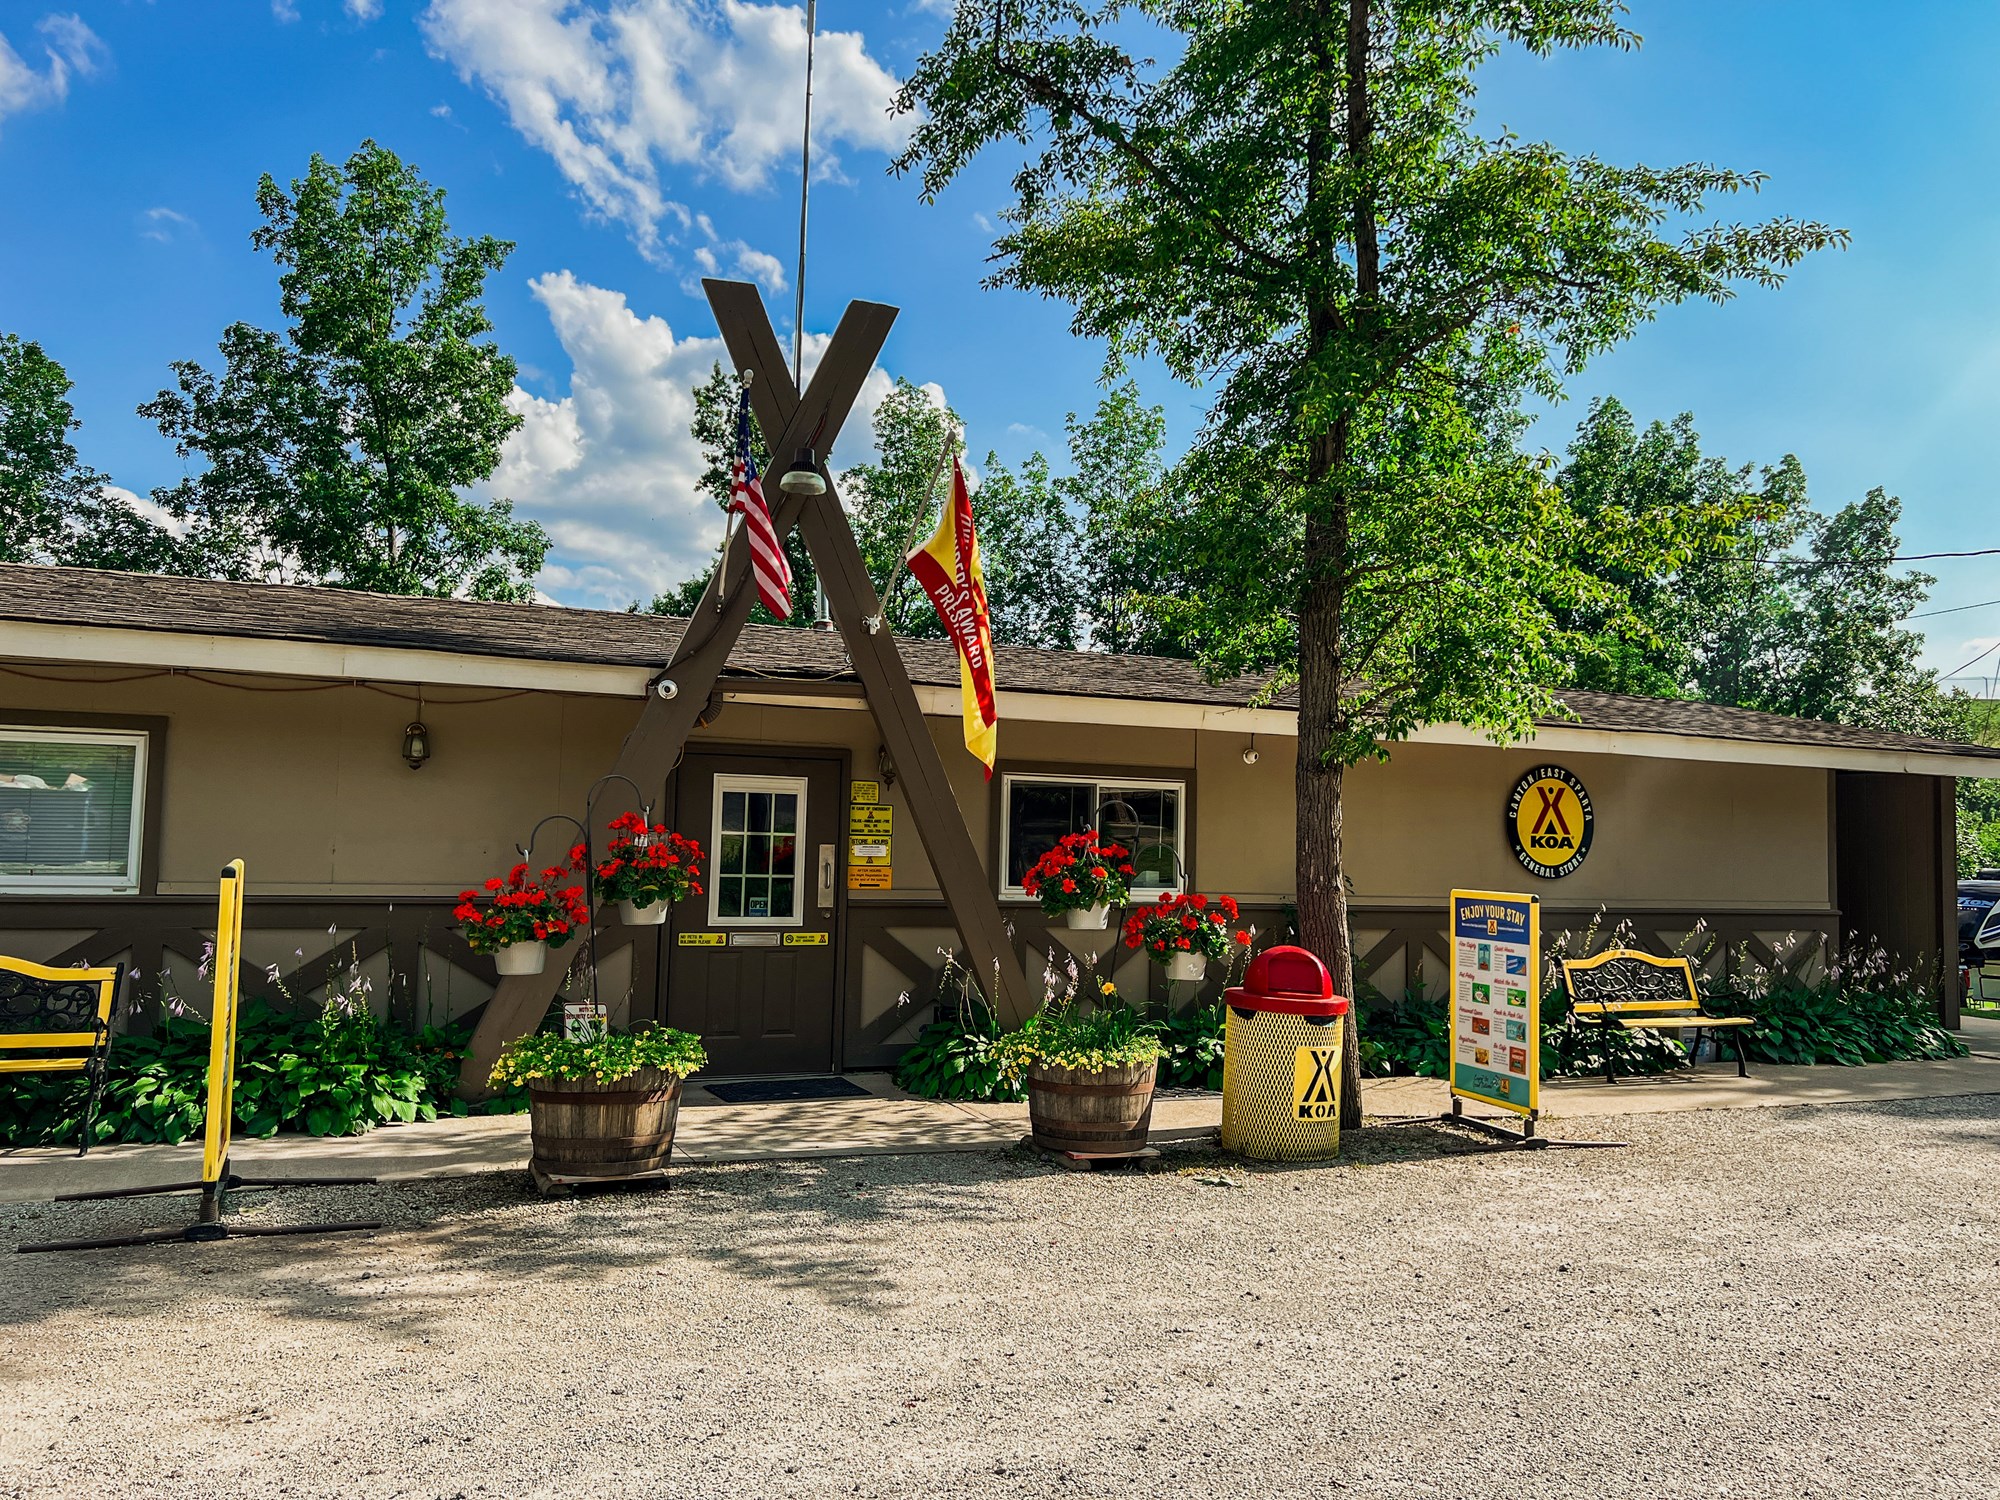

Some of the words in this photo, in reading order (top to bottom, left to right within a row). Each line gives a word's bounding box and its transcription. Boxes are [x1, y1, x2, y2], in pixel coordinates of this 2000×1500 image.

[958, 607, 983, 669] AWARD
[1569, 777, 1593, 821] SPARTA
[1530, 835, 1575, 850] KOA
[1518, 851, 1556, 878] GENERAL
[1559, 853, 1584, 876] STORE
[1460, 905, 1484, 920] ENJOY
[1485, 904, 1505, 920] YOUR
[1506, 908, 1526, 926] STAY
[1298, 1103, 1337, 1119] KOA
